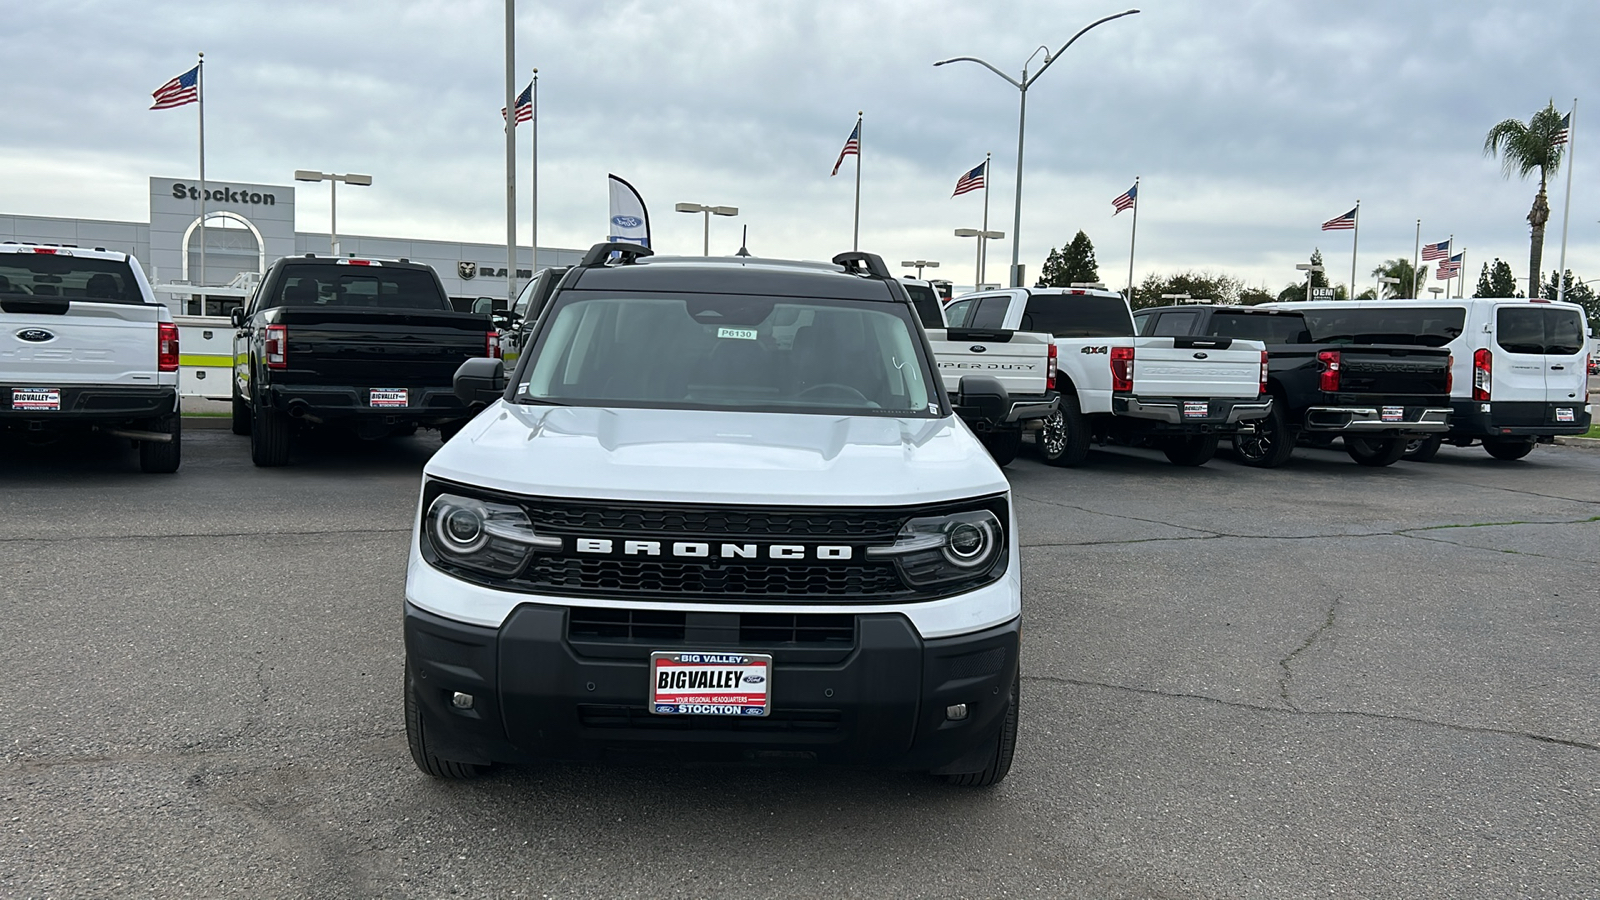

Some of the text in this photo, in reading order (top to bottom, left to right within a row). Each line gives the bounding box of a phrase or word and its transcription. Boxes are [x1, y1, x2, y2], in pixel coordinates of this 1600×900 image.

[172, 183, 275, 205] Stockton
[480, 267, 532, 278] RAM
[1313, 288, 1333, 296] OEM
[721, 330, 751, 338] P6130
[0, 347, 115, 362] -150
[577, 538, 852, 559] BRONCO
[703, 655, 742, 663] VALLEY
[657, 670, 744, 689] BIGVALLEY
[678, 704, 741, 714] STOCKTON
